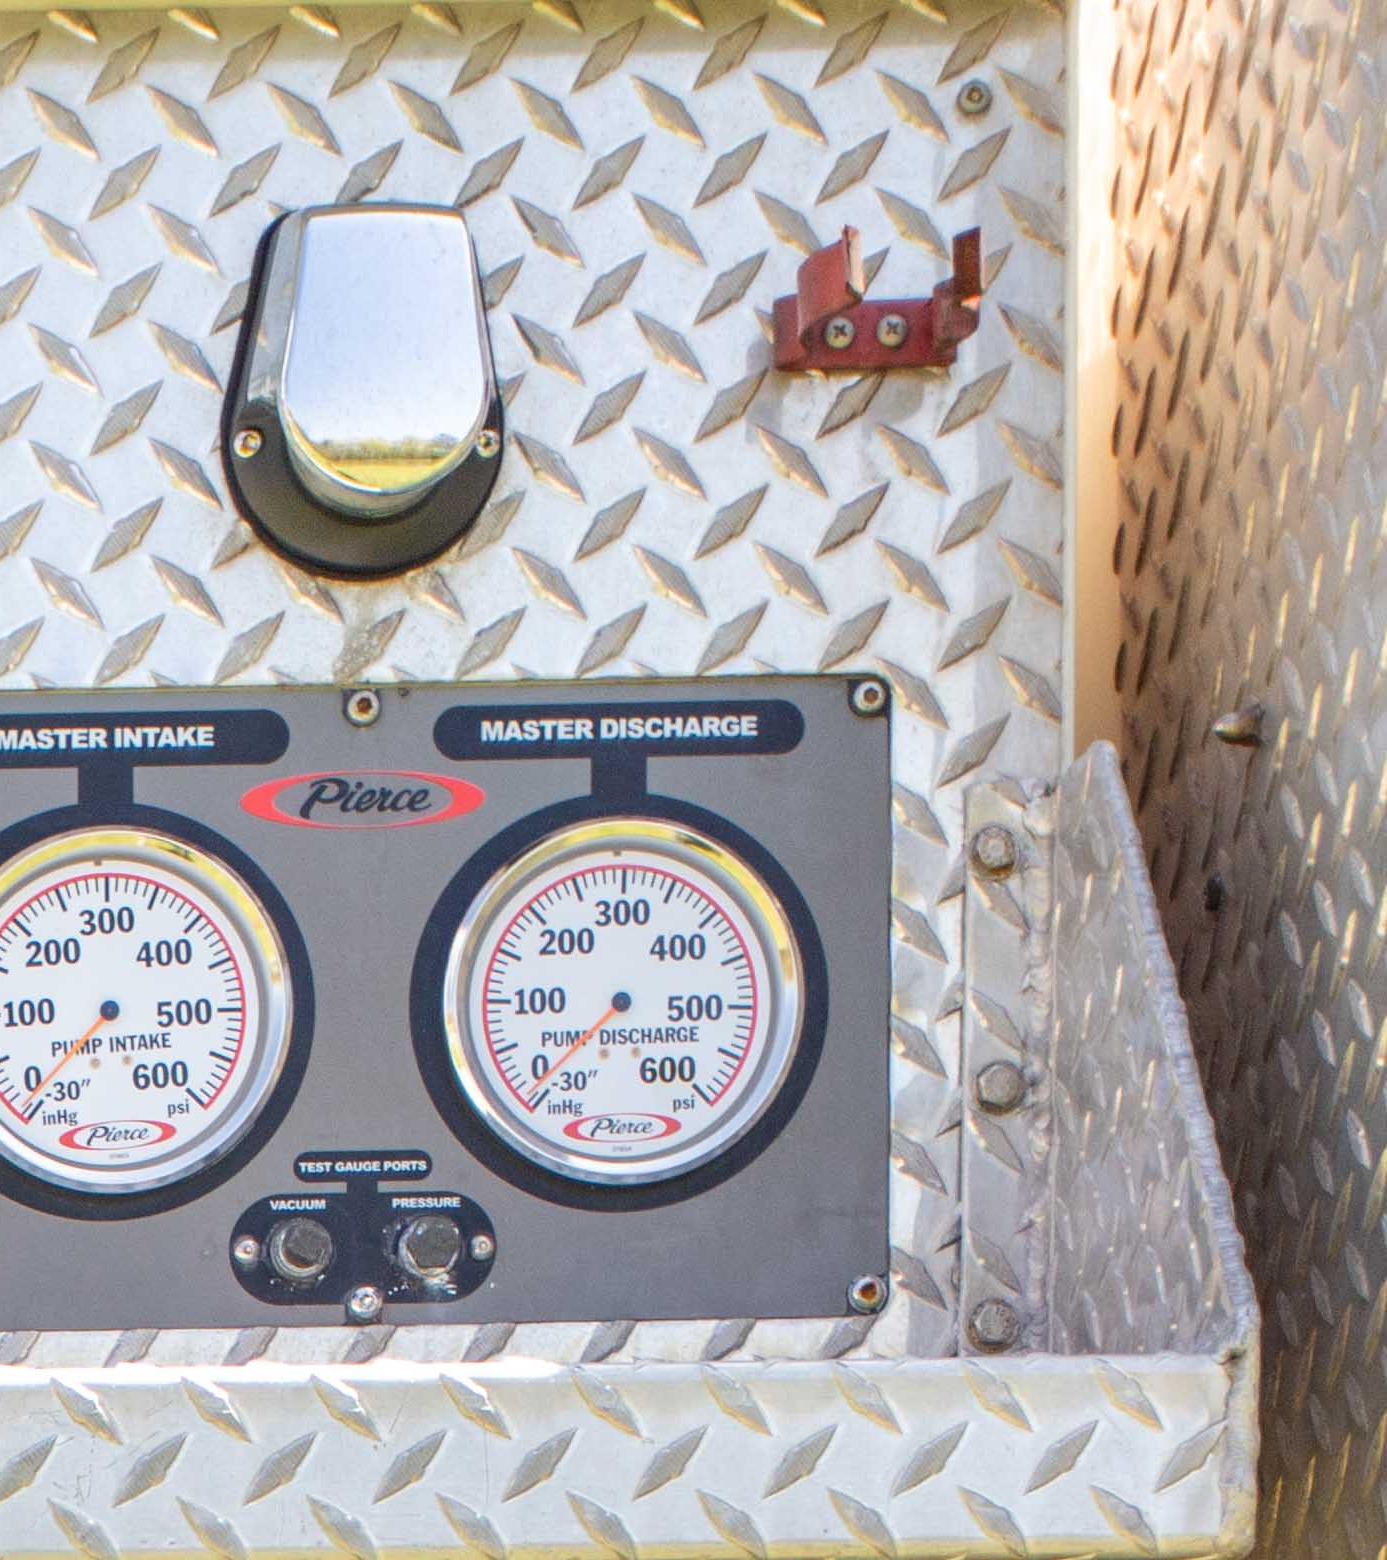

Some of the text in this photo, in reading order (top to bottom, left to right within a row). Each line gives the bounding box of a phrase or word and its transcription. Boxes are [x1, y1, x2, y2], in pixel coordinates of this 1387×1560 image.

[113, 725, 214, 749] INTAKE
[481, 714, 758, 742] MASTER DISCHARGE
[301, 775, 431, 818] Pierce
[80, 907, 134, 935] 300
[25, 939, 81, 967] 200
[137, 938, 191, 966] 400
[2, 998, 54, 1027] 100
[541, 1026, 699, 1047] PUMP DISCHARGE
[299, 1159, 428, 1173] TEST GAUGE PORTS
[270, 1199, 325, 1210] VACUUM
[392, 1196, 460, 1208] PRESSURE
